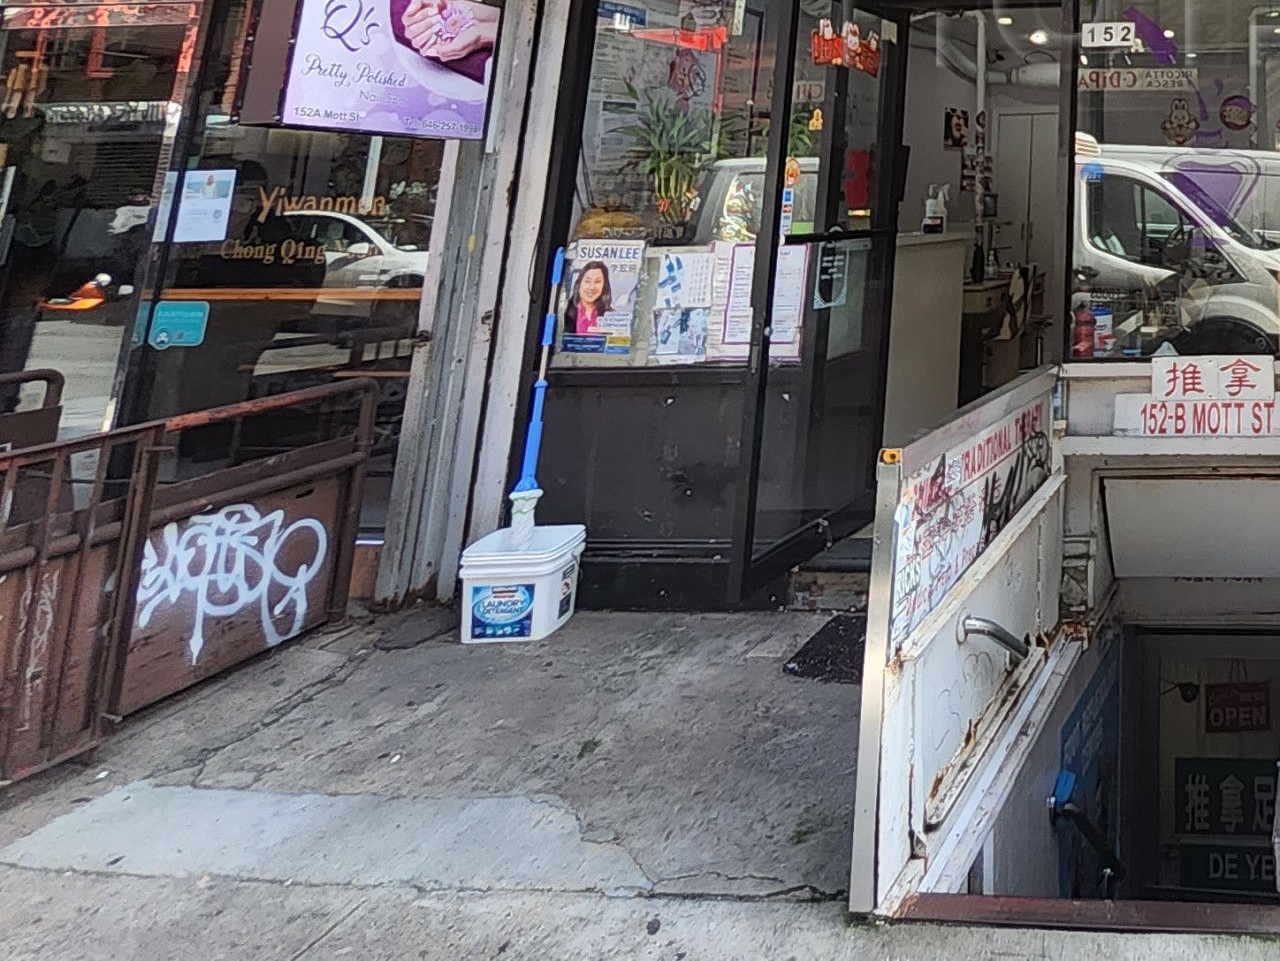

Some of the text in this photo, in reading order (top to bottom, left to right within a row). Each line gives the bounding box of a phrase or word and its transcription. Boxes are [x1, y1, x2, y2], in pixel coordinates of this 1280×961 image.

[1086, 25, 1131, 43] 152
[301, 53, 407, 88] Pretty Polished
[294, 107, 321, 118] 152A
[324, 110, 347, 121] Mott
[219, 239, 276, 264] Chong
[280, 238, 326, 265] Qing
[579, 246, 639, 260] SUSAN LEE
[1164, 358, 1262, 398] 推拿
[1140, 401, 1275, 435] 152-B MOTT ST
[482, 598, 524, 608] LAUNDRY
[1209, 707, 1267, 727] OPEN
[1185, 773, 1274, 833] 推拿足
[1209, 853, 1239, 879] DE
